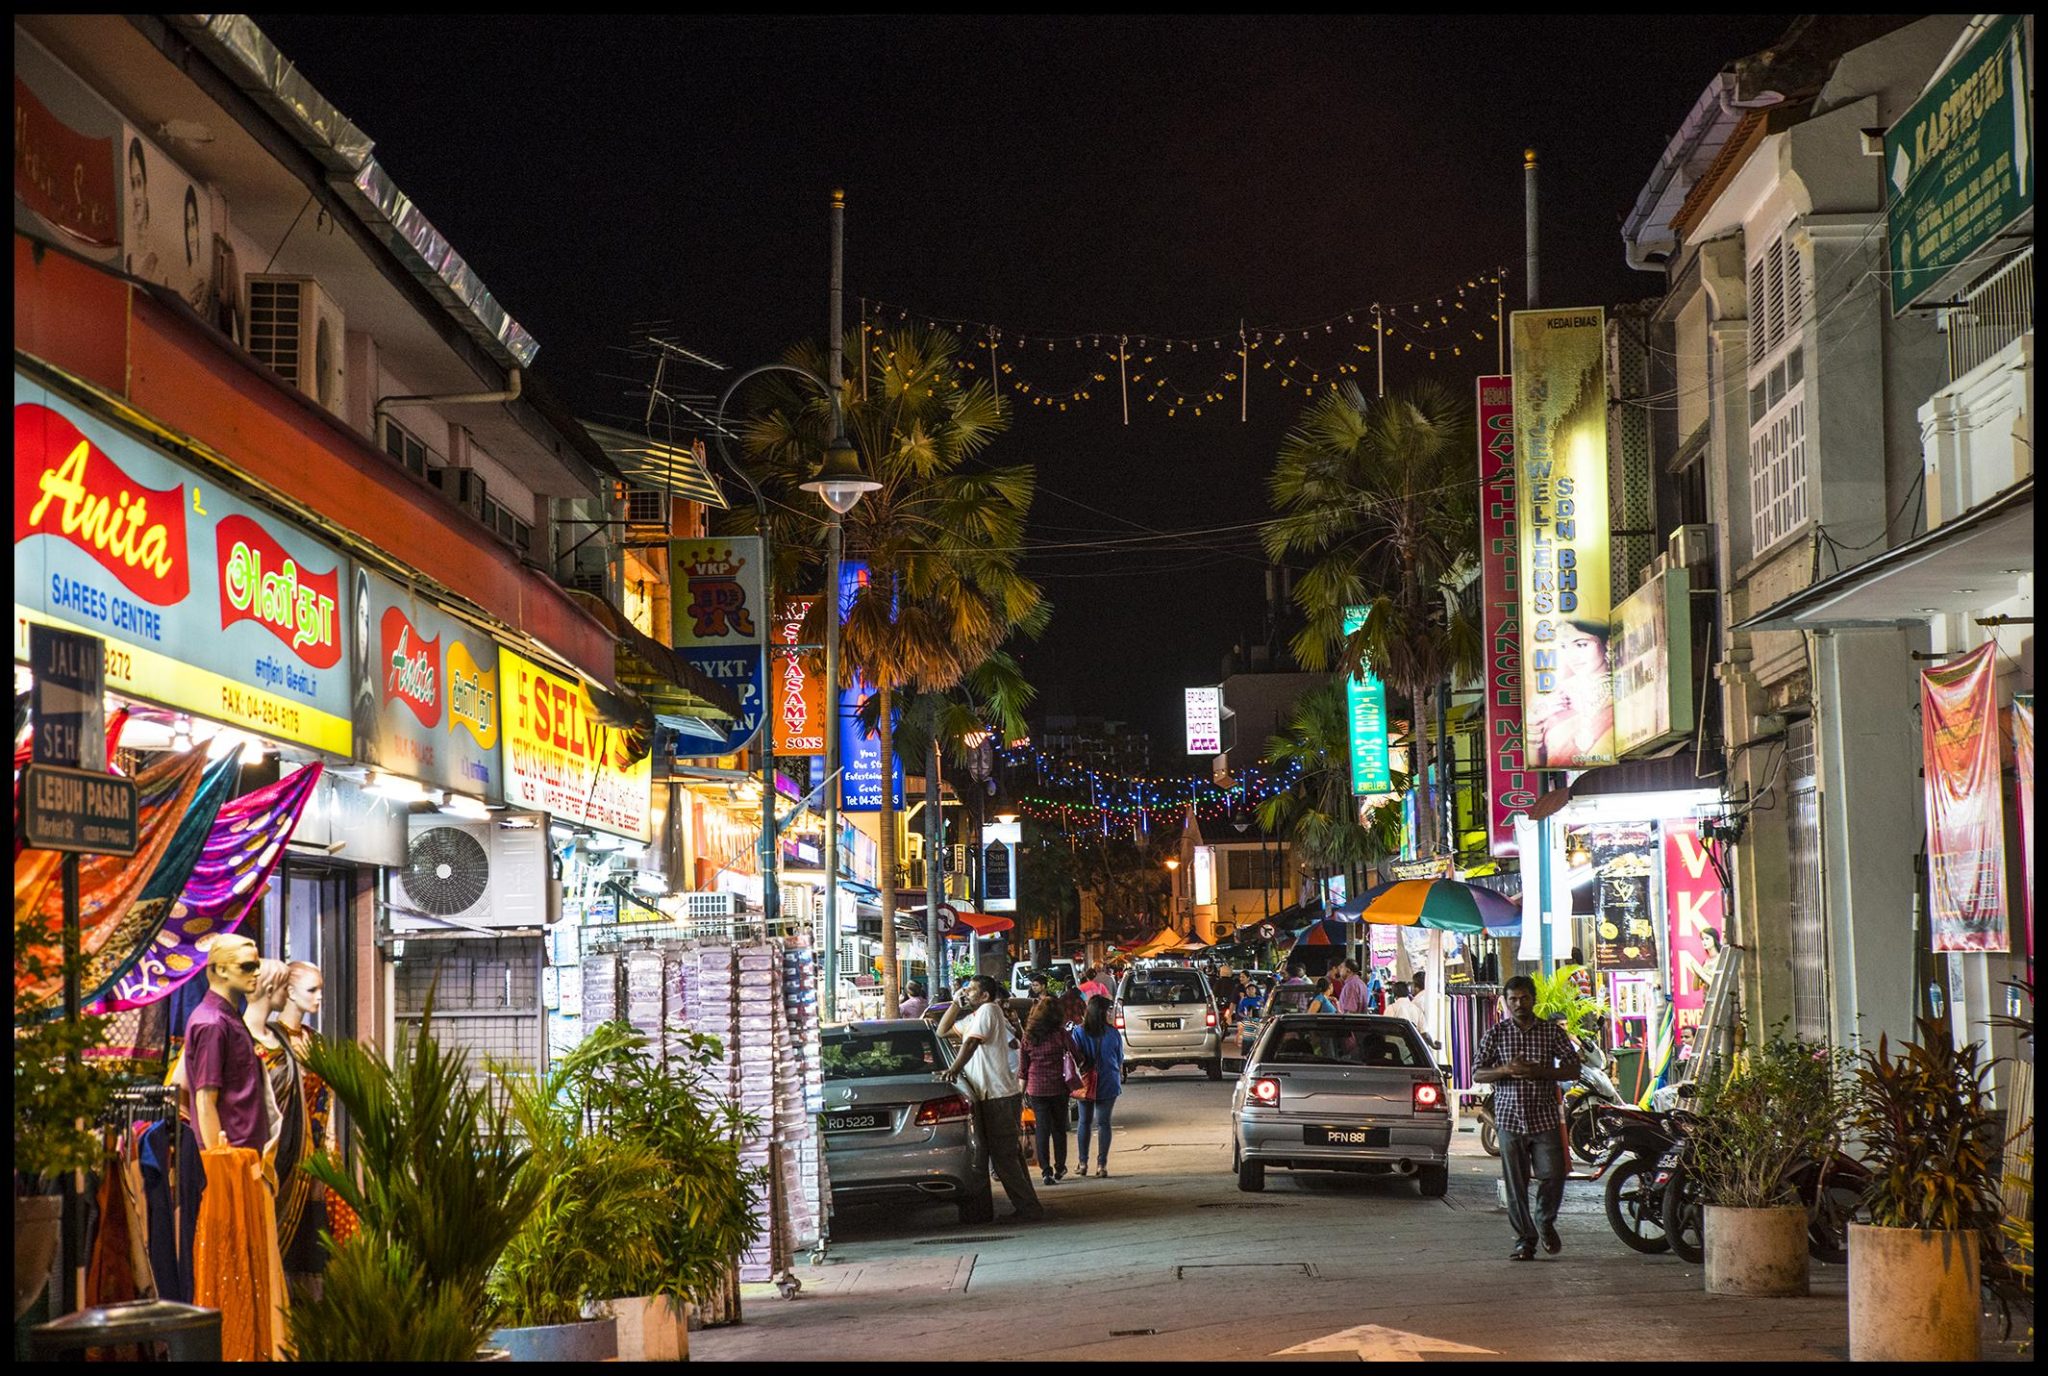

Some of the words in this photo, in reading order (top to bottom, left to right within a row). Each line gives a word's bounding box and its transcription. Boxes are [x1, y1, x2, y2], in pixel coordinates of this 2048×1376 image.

[1548, 317, 1574, 329] KEDAI
[1574, 316, 1598, 328] EMAS
[29, 440, 173, 579] Anita
[1555, 477, 1575, 541] SDN
[696, 562, 730, 575] VKP
[1557, 548, 1578, 613] BHD
[52, 573, 107, 621] SAREES
[111, 597, 162, 642] CENTRE
[389, 624, 436, 707] Anita
[1188, 707, 1217, 719] BUDGET
[1189, 722, 1218, 734] HOTEL
[785, 736, 823, 749] SONS
[36, 773, 82, 815] LEBUH
[86, 781, 129, 820] PASAR
[847, 1115, 875, 1128] 5223
[1328, 1131, 1349, 1143] PFN
[1349, 1132, 1365, 1143] 881
